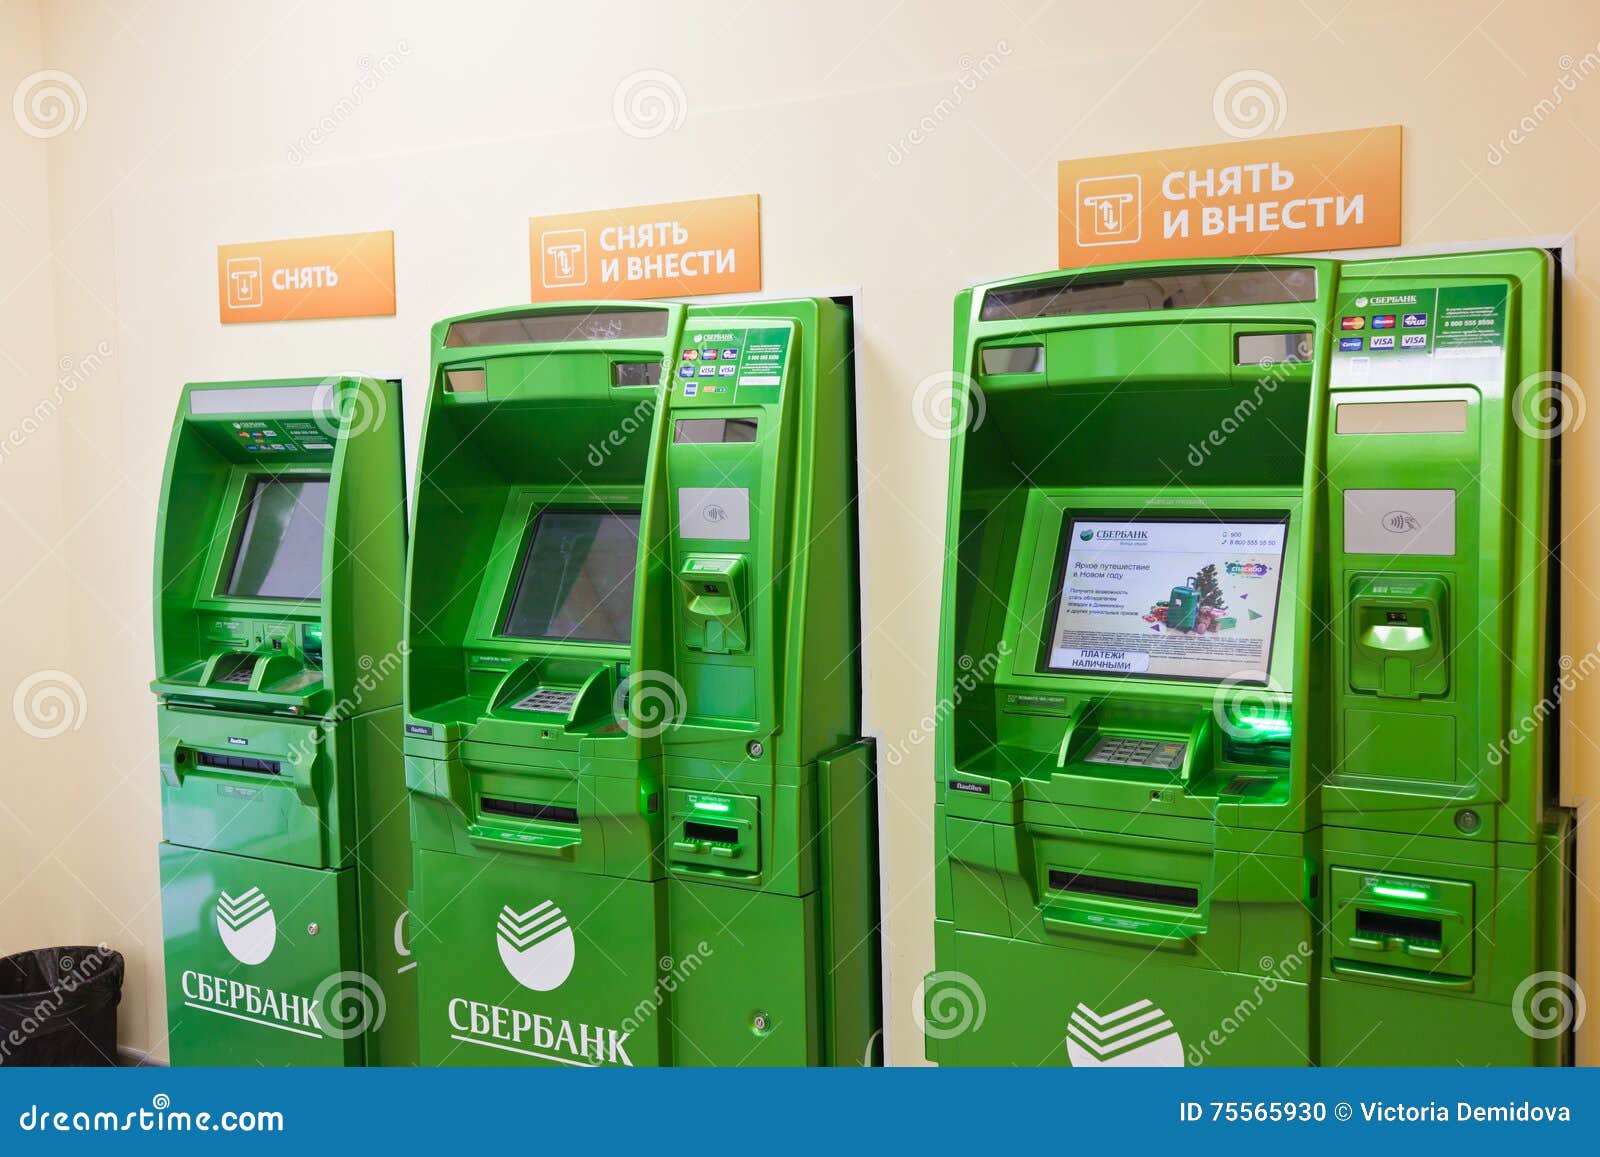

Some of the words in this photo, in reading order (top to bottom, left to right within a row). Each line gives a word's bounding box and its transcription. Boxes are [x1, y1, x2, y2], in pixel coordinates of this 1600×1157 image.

[1161, 162, 1295, 201] СНЯТЬ
[1162, 209, 1189, 239] И
[1202, 194, 1364, 237] ВНЕСТИ
[599, 221, 689, 252] СНЯТЬ
[271, 265, 339, 290] СНЯТЬ
[601, 258, 619, 283] И
[627, 248, 736, 281] ВНЕСТИ
[1370, 295, 1416, 304] СБЕРБАНК
[1404, 336, 1425, 344] VISA
[1096, 530, 1148, 540] СБЕРБАНК
[1075, 562, 1098, 570] Яркое
[1100, 563, 1151, 571] путешествие
[1072, 659, 1131, 670] НАЛИЧНЫМИ
[1080, 650, 1125, 660] ПЛАТЕЖИ
[181, 969, 323, 1030] СБЕРБАНК
[448, 997, 634, 1067] СБЕРБАНК
